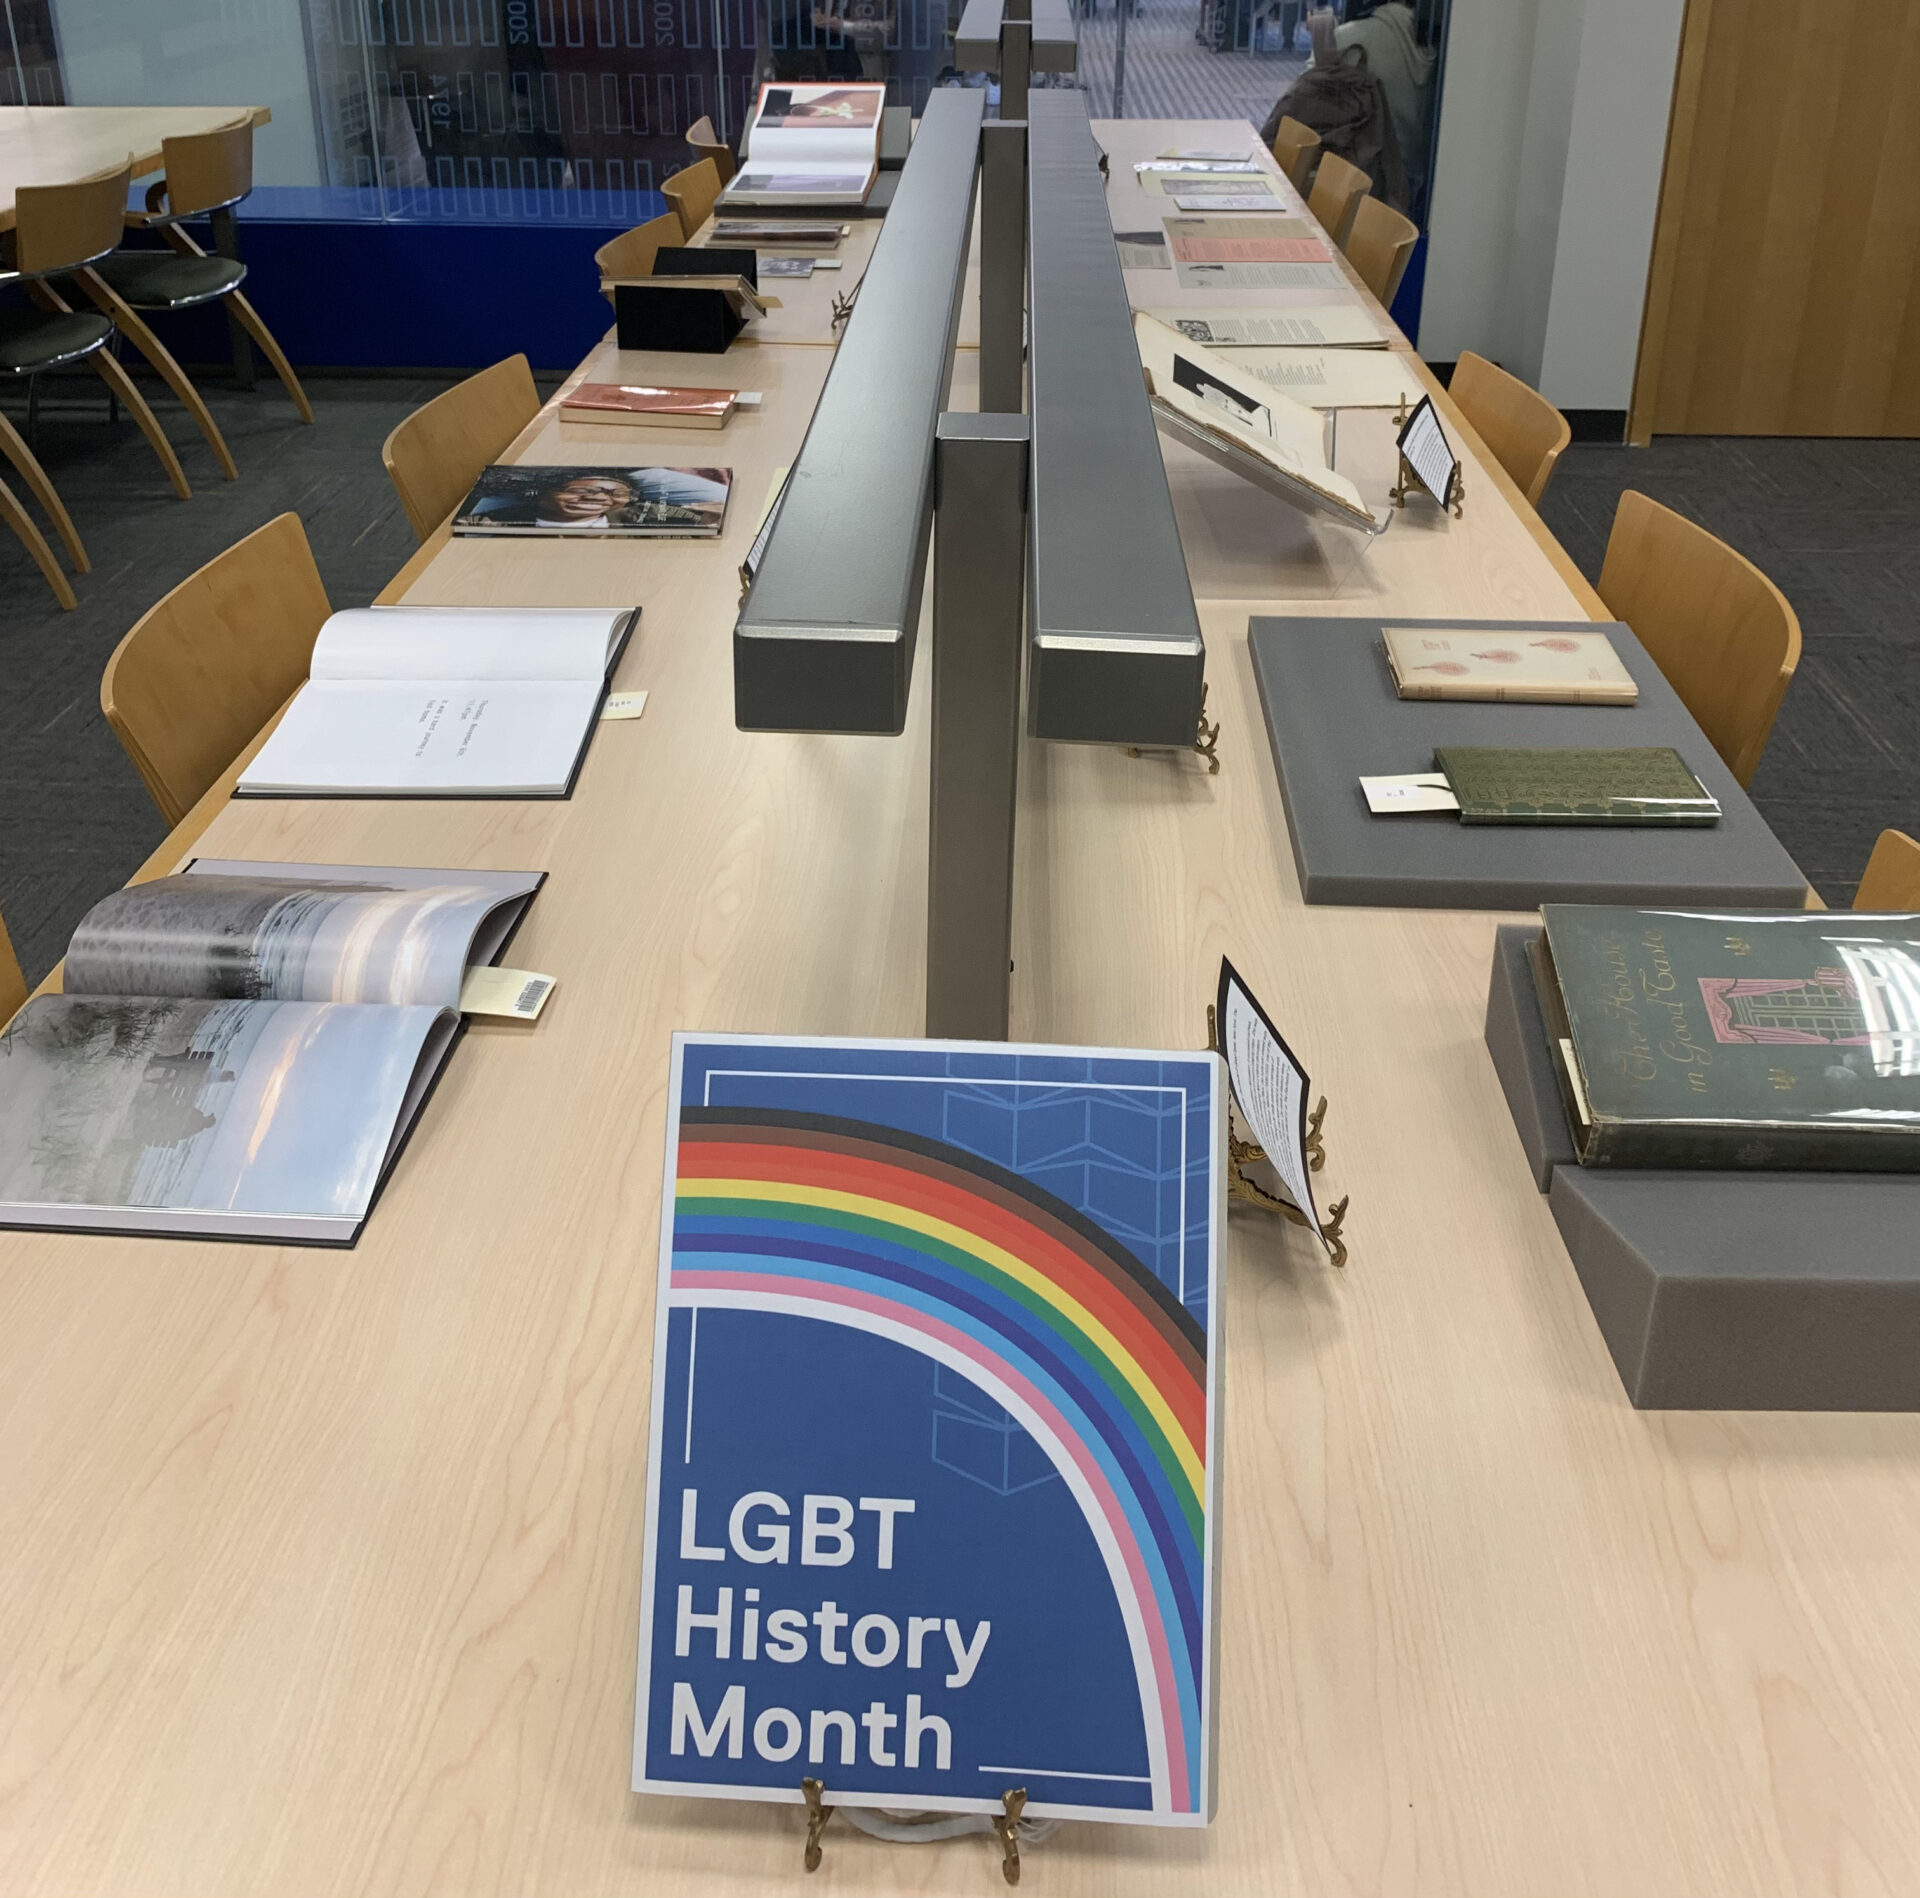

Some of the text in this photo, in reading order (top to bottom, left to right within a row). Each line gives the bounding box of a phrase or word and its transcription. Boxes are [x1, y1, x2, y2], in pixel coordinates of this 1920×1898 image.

[1603, 937, 1640, 1025] House
[1639, 930, 1713, 1092] in Good Taste
[680, 1488, 916, 1570] LGBT
[674, 1584, 991, 1688] History
[670, 1681, 952, 1770] Month
